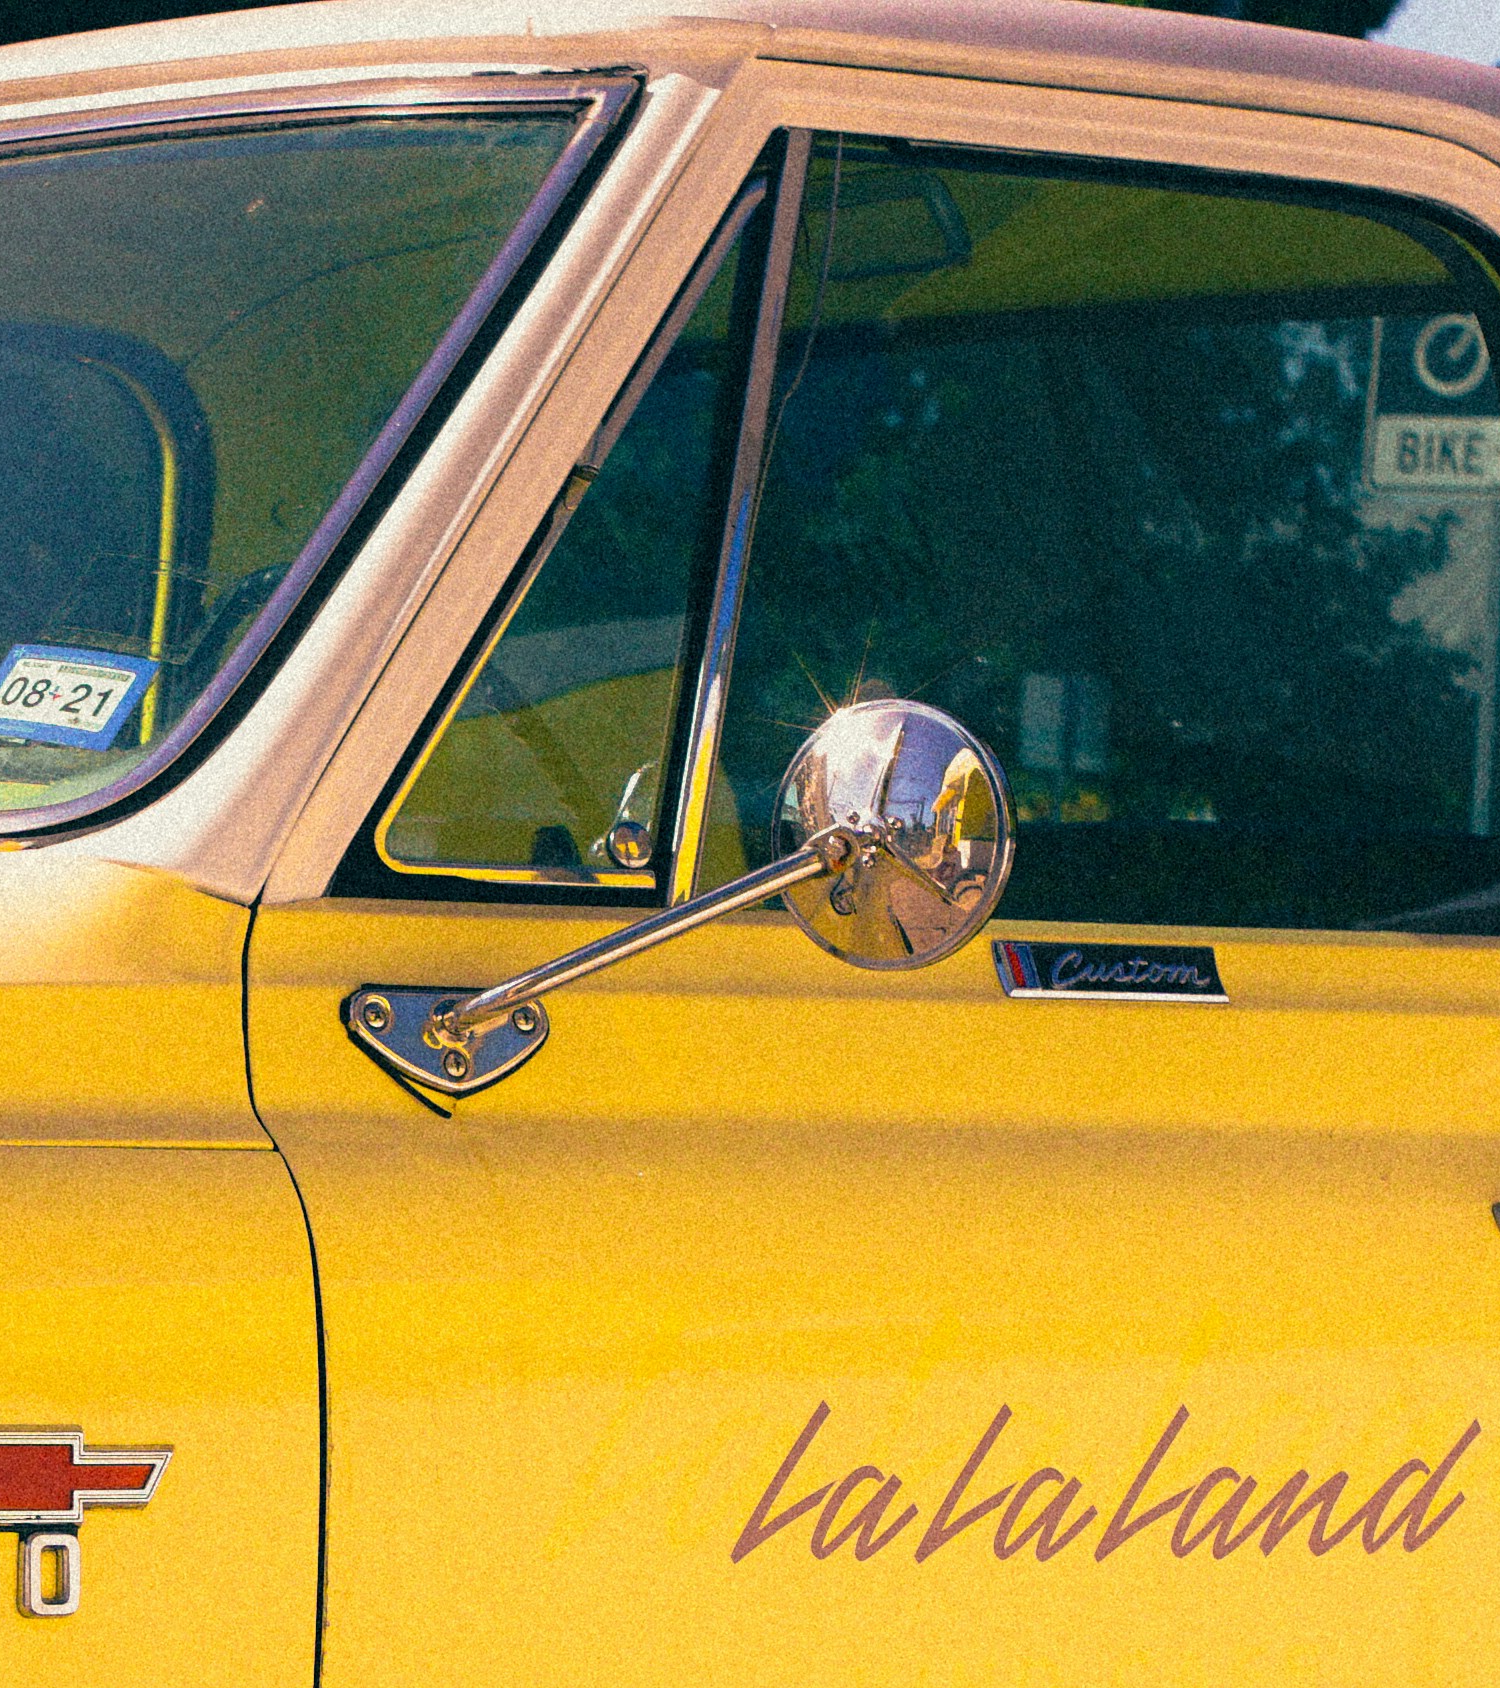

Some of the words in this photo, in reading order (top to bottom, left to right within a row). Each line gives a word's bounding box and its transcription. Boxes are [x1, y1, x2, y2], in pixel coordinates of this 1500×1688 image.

[1397, 428, 1486, 475] BIKE
[1, 676, 52, 709] 08
[60, 682, 114, 717] 21
[1050, 948, 1212, 989] Custom
